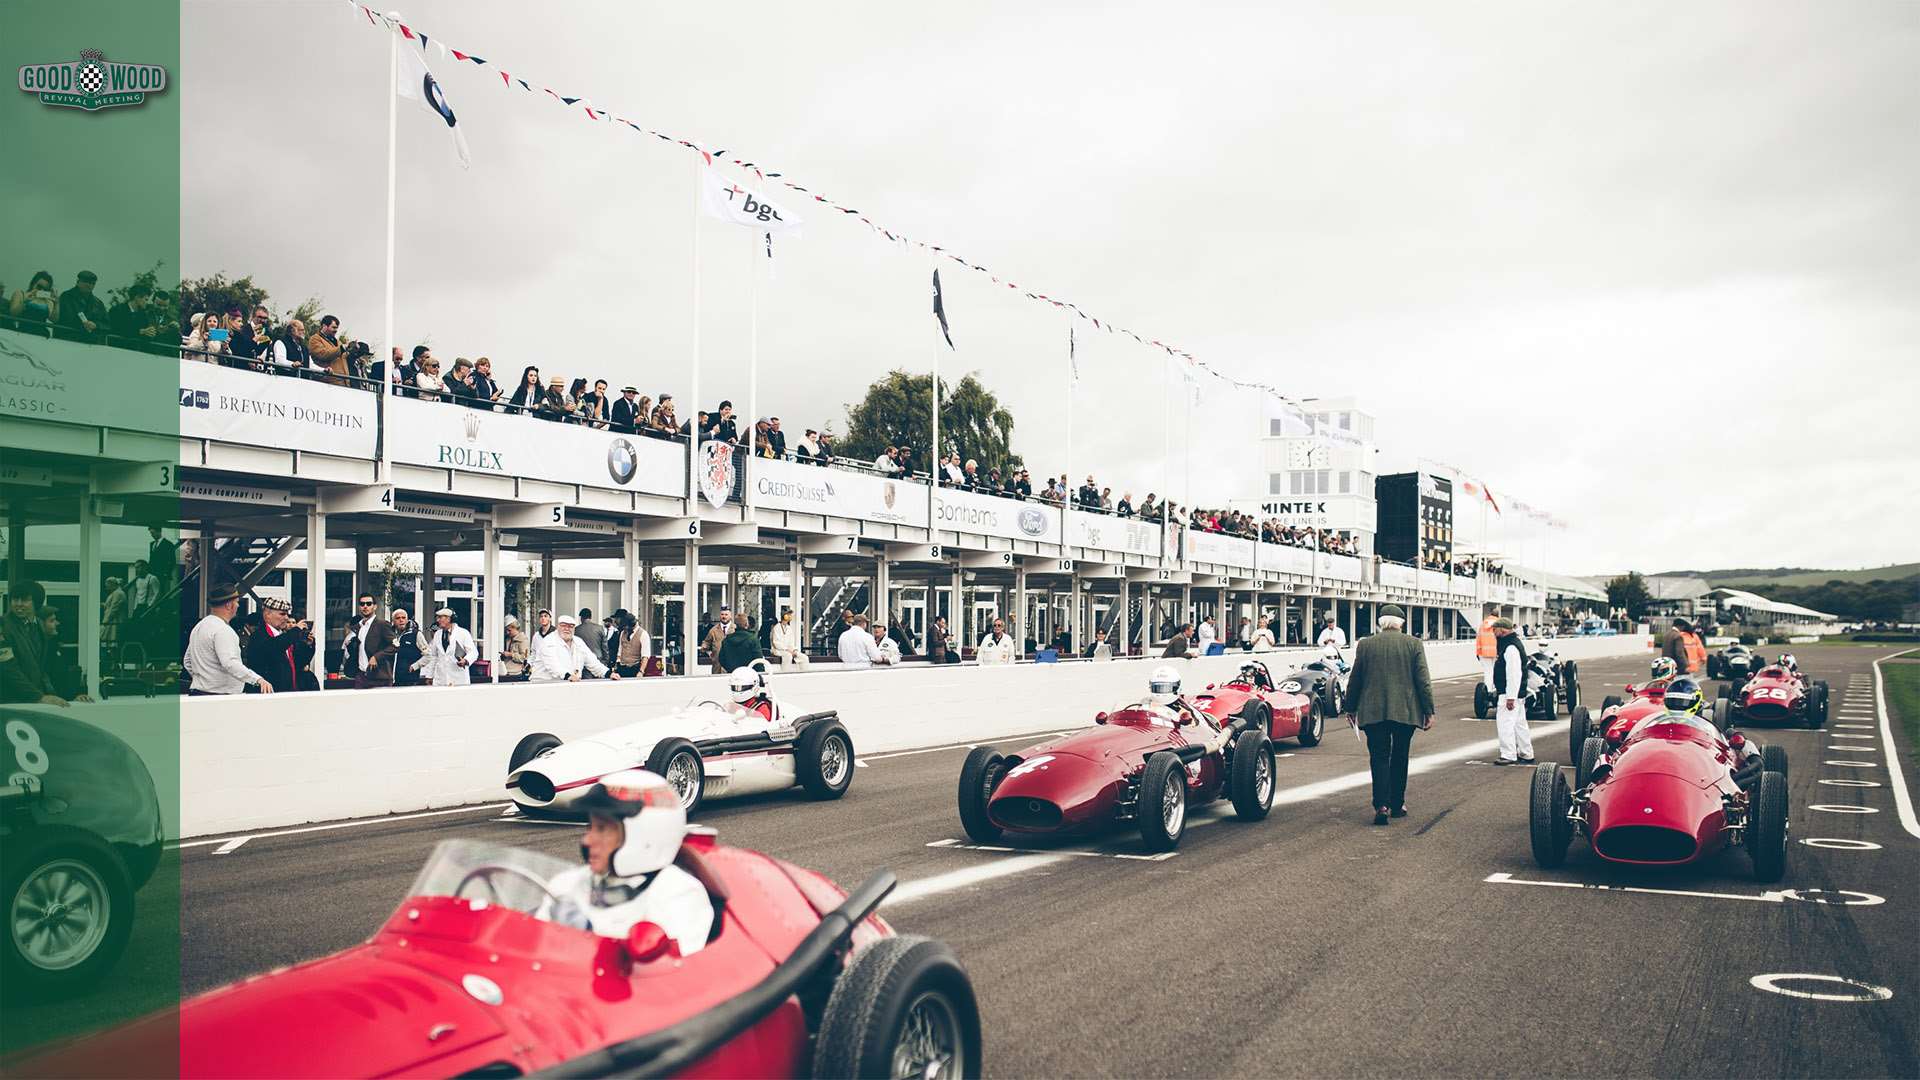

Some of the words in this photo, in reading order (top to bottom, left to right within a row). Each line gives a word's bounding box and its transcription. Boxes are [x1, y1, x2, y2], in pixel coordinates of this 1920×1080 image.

[219, 395, 286, 418] BREWIN
[293, 406, 363, 429] DOLPHIN
[438, 444, 504, 471] ROLEX
[160, 466, 170, 486] 3
[198, 488, 213, 497] CAR
[215, 489, 249, 500] COMPANY
[251, 491, 264, 500] LTD
[758, 477, 796, 498] CREDIT
[796, 481, 827, 503] SUISSE
[381, 489, 392, 506] 4
[552, 506, 561, 522] 5
[934, 497, 999, 528] Bonhams
[688, 520, 697, 535] 6
[847, 537, 856, 550] 7
[931, 545, 940, 558] 8
[1003, 553, 1011, 564] 9
[1058, 560, 1071, 571] 10
[1114, 565, 1124, 576] 11
[1158, 570, 1169, 580] 12
[1217, 576, 1228, 585] 14
[1252, 580, 1263, 589] 15
[1282, 583, 1293, 592] 16
[1310, 586, 1320, 594] 17
[1336, 588, 1346, 597] 18
[1359, 591, 1369, 599] 19
[1753, 687, 1788, 700] 28
[5, 720, 50, 776] 8
